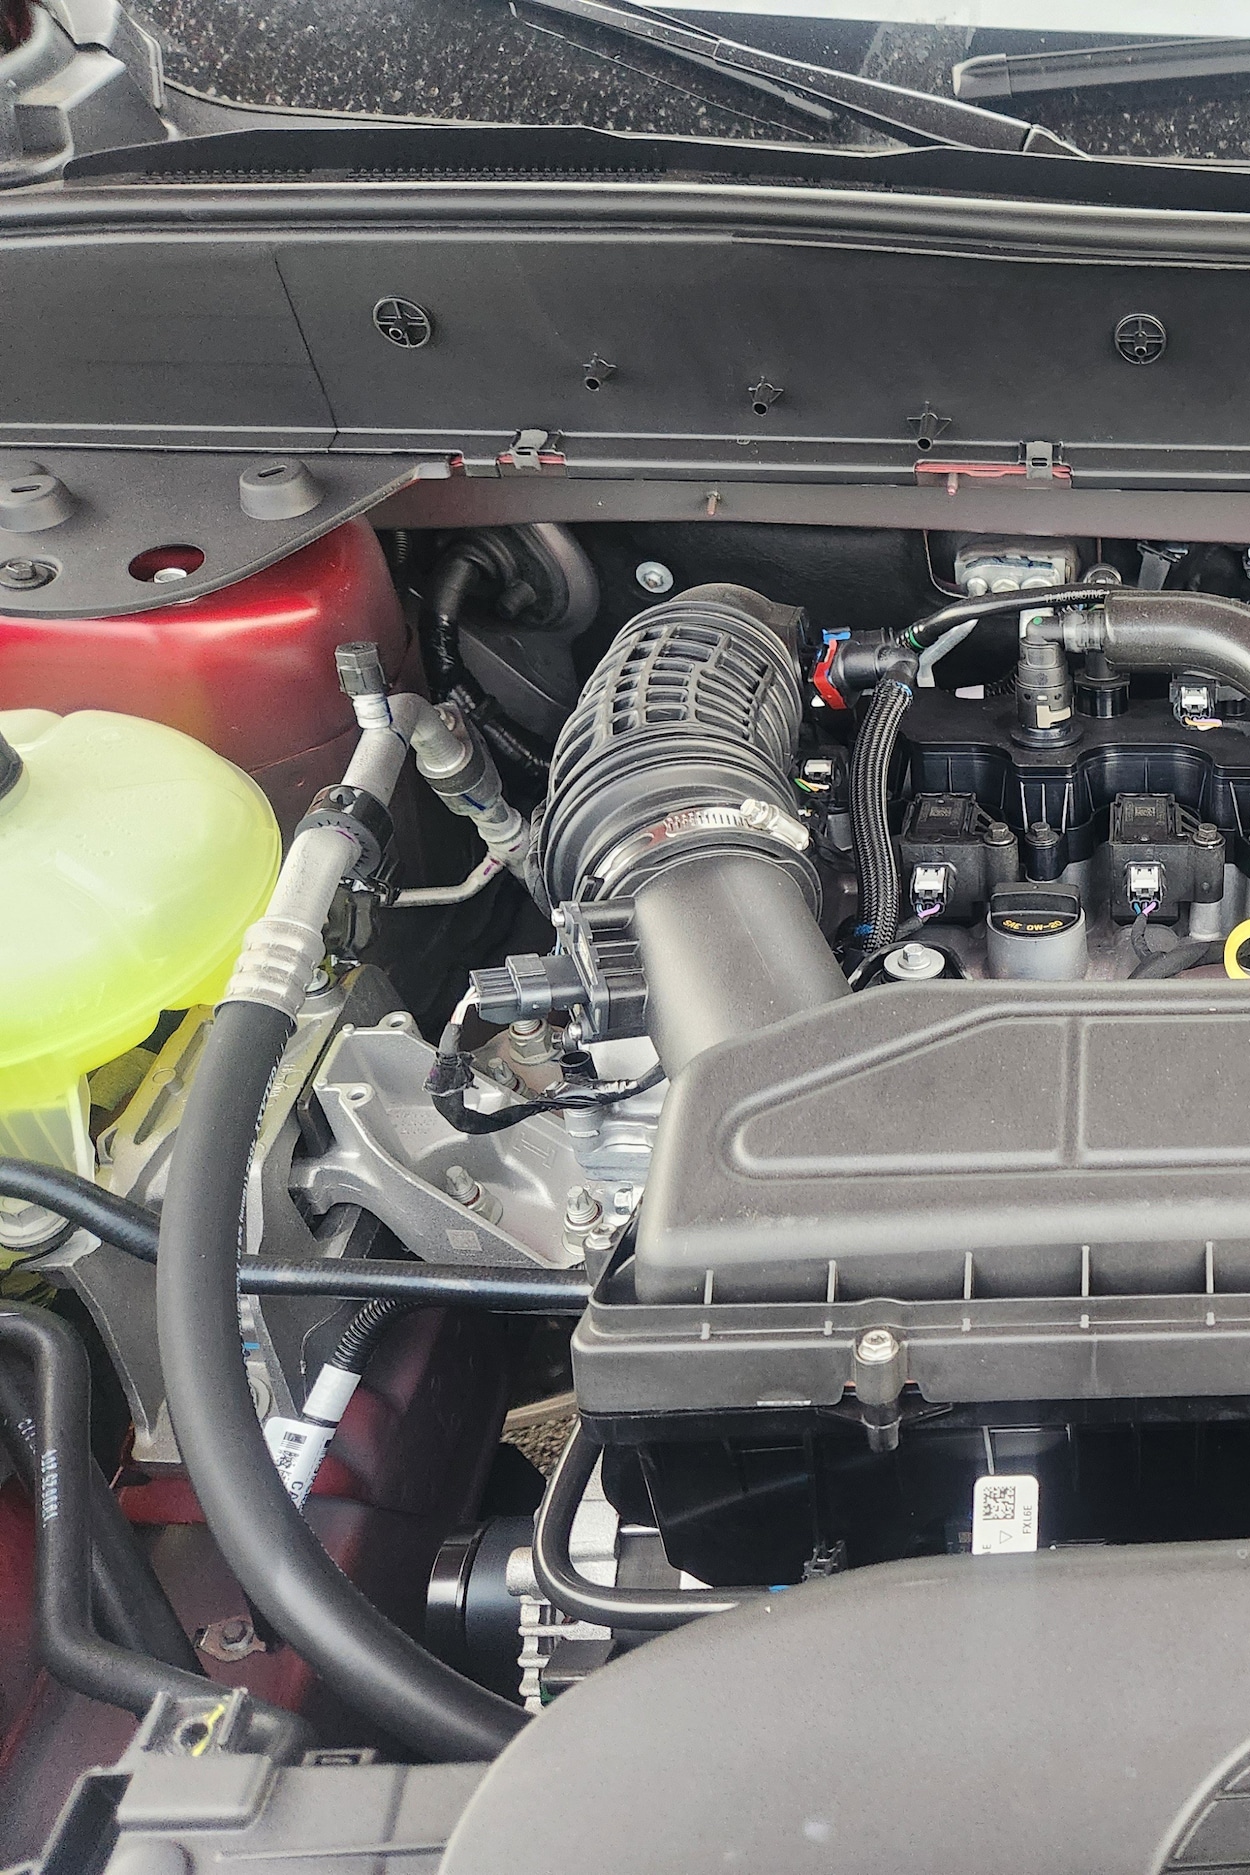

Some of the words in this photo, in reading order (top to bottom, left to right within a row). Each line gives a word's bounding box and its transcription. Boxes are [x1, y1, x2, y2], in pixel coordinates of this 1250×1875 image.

[1055, 589, 1104, 602] AUTOMOTIVE
[1002, 919, 1022, 930] SAE
[1026, 920, 1064, 931] 0W-20
[1022, 1505, 1033, 1534] FXL6E
